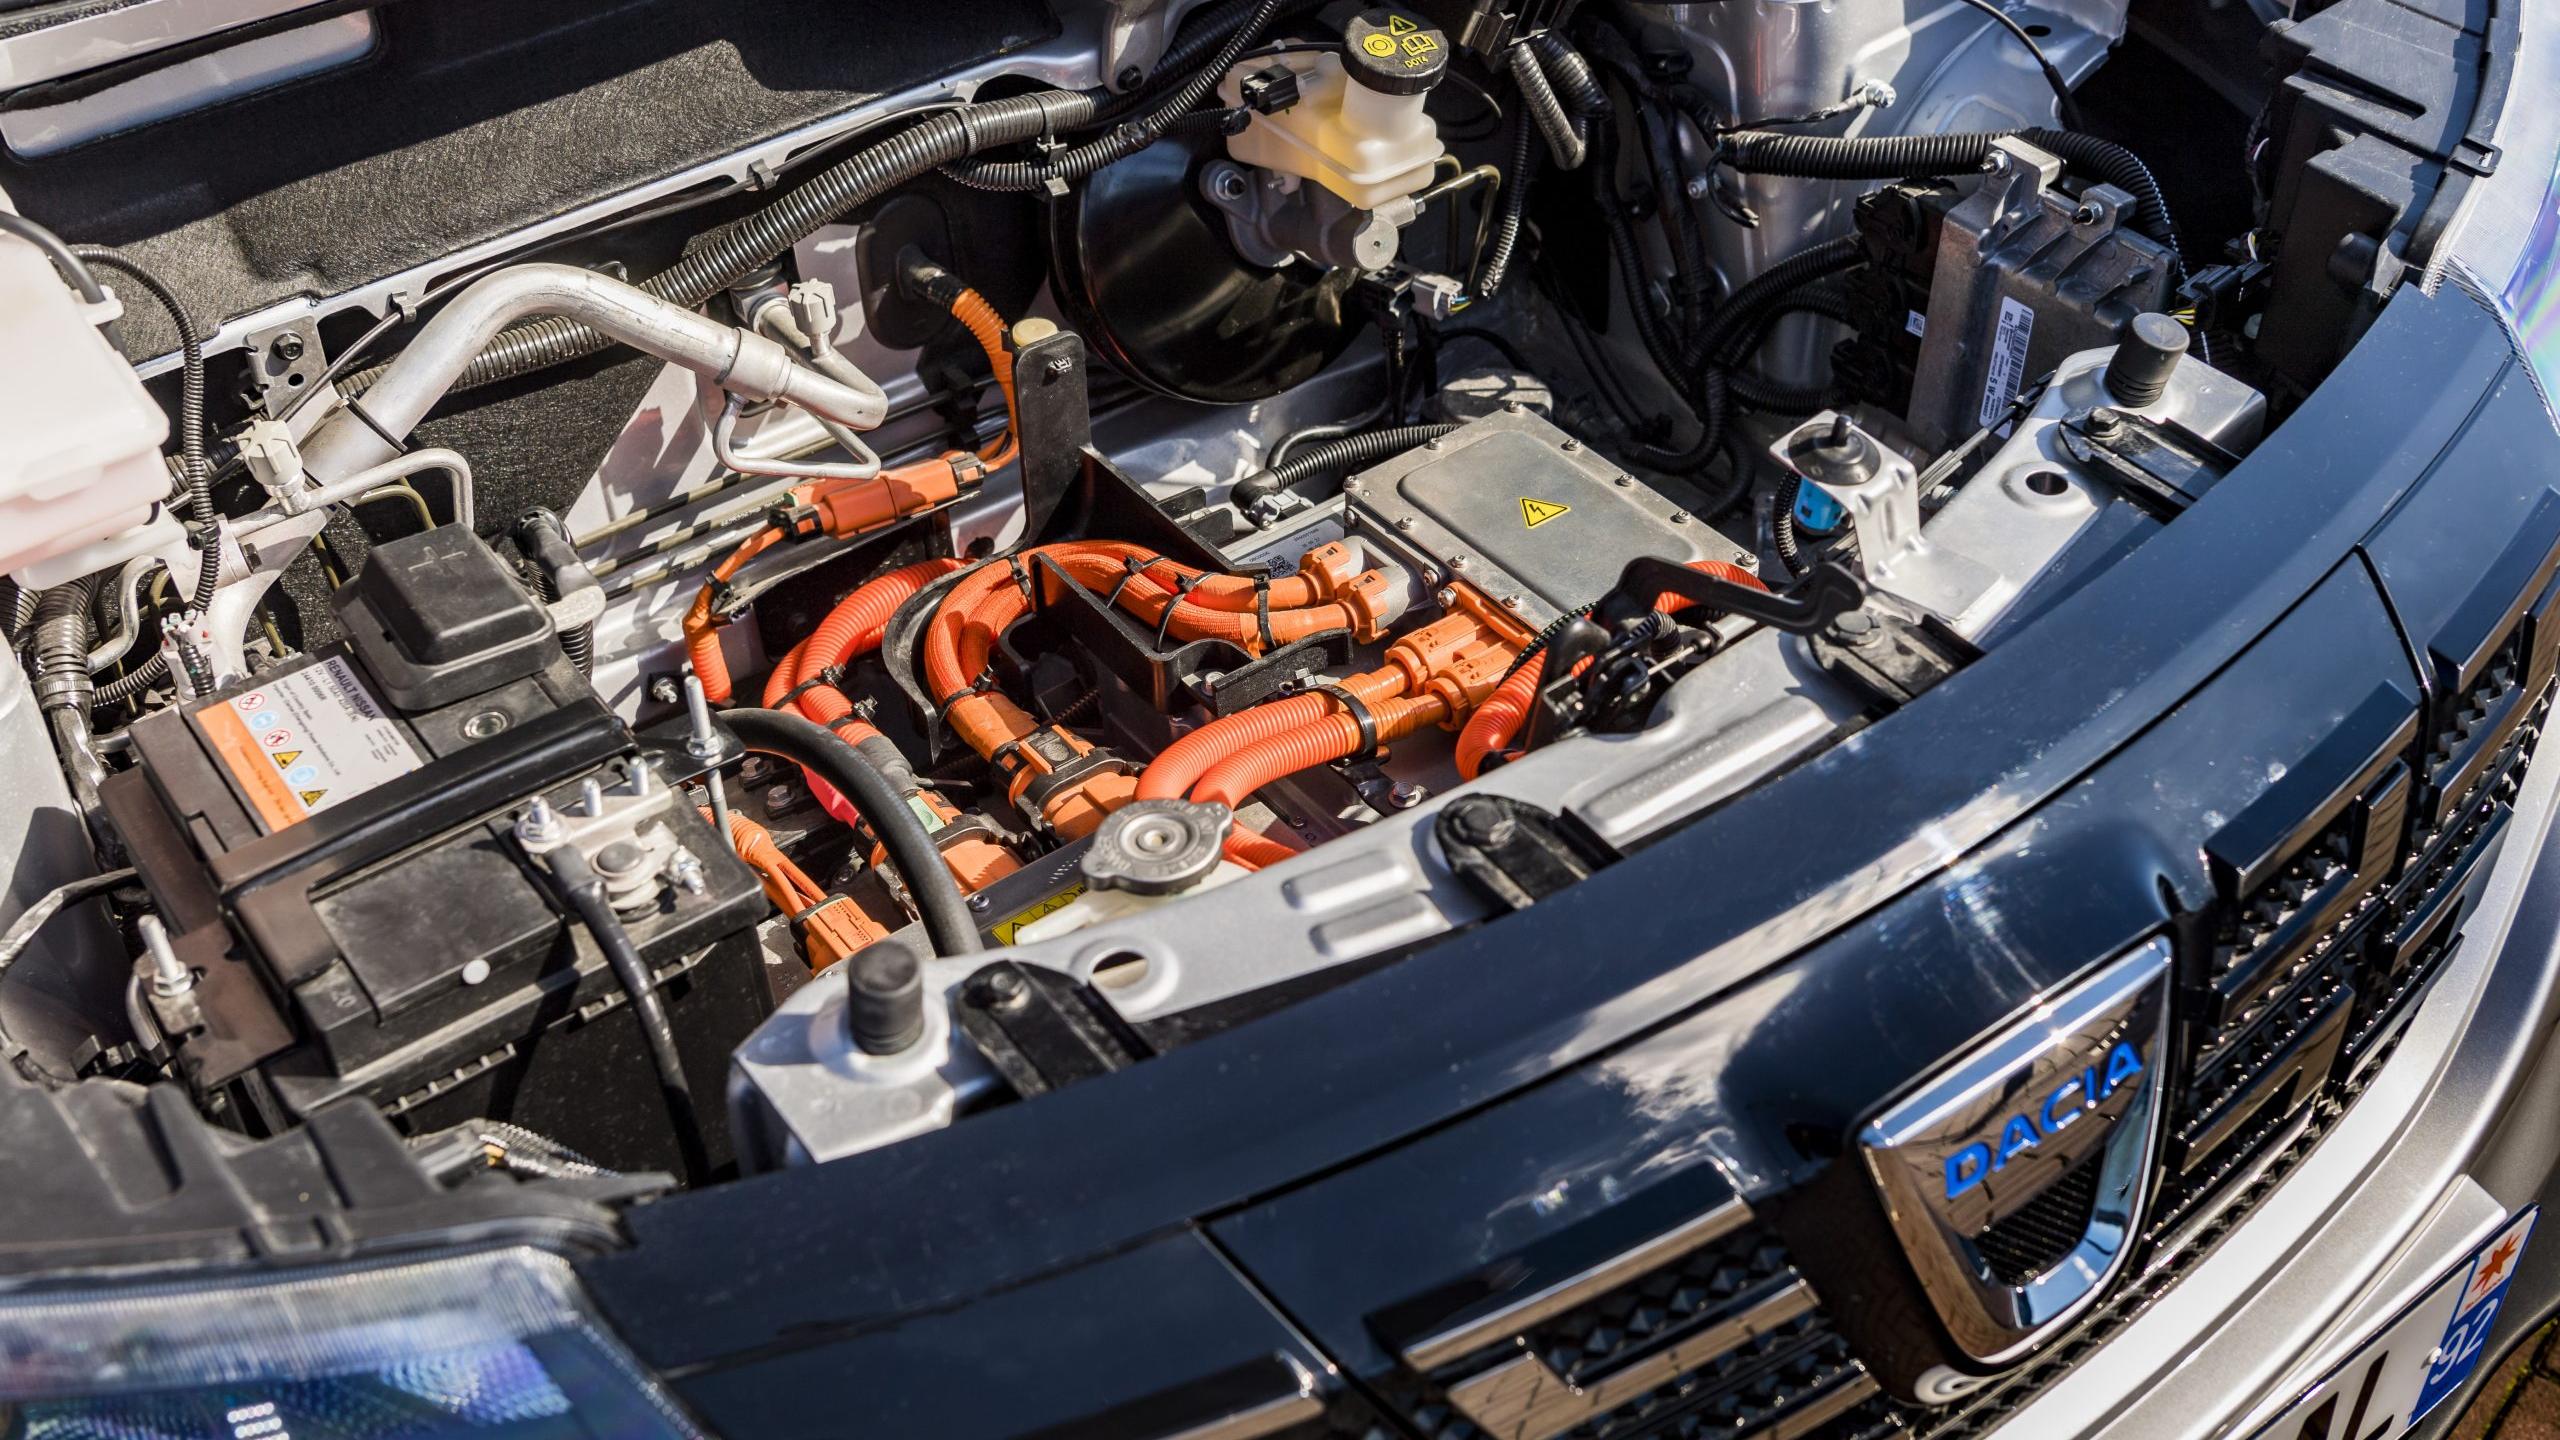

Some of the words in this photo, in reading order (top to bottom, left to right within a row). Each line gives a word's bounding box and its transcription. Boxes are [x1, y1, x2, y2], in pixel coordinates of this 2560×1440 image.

[324, 659, 358, 694] RENAULT
[350, 692, 378, 721] NISSAN
[1943, 1041, 2143, 1199] DACIA
[2430, 1297, 2499, 1386] 92
